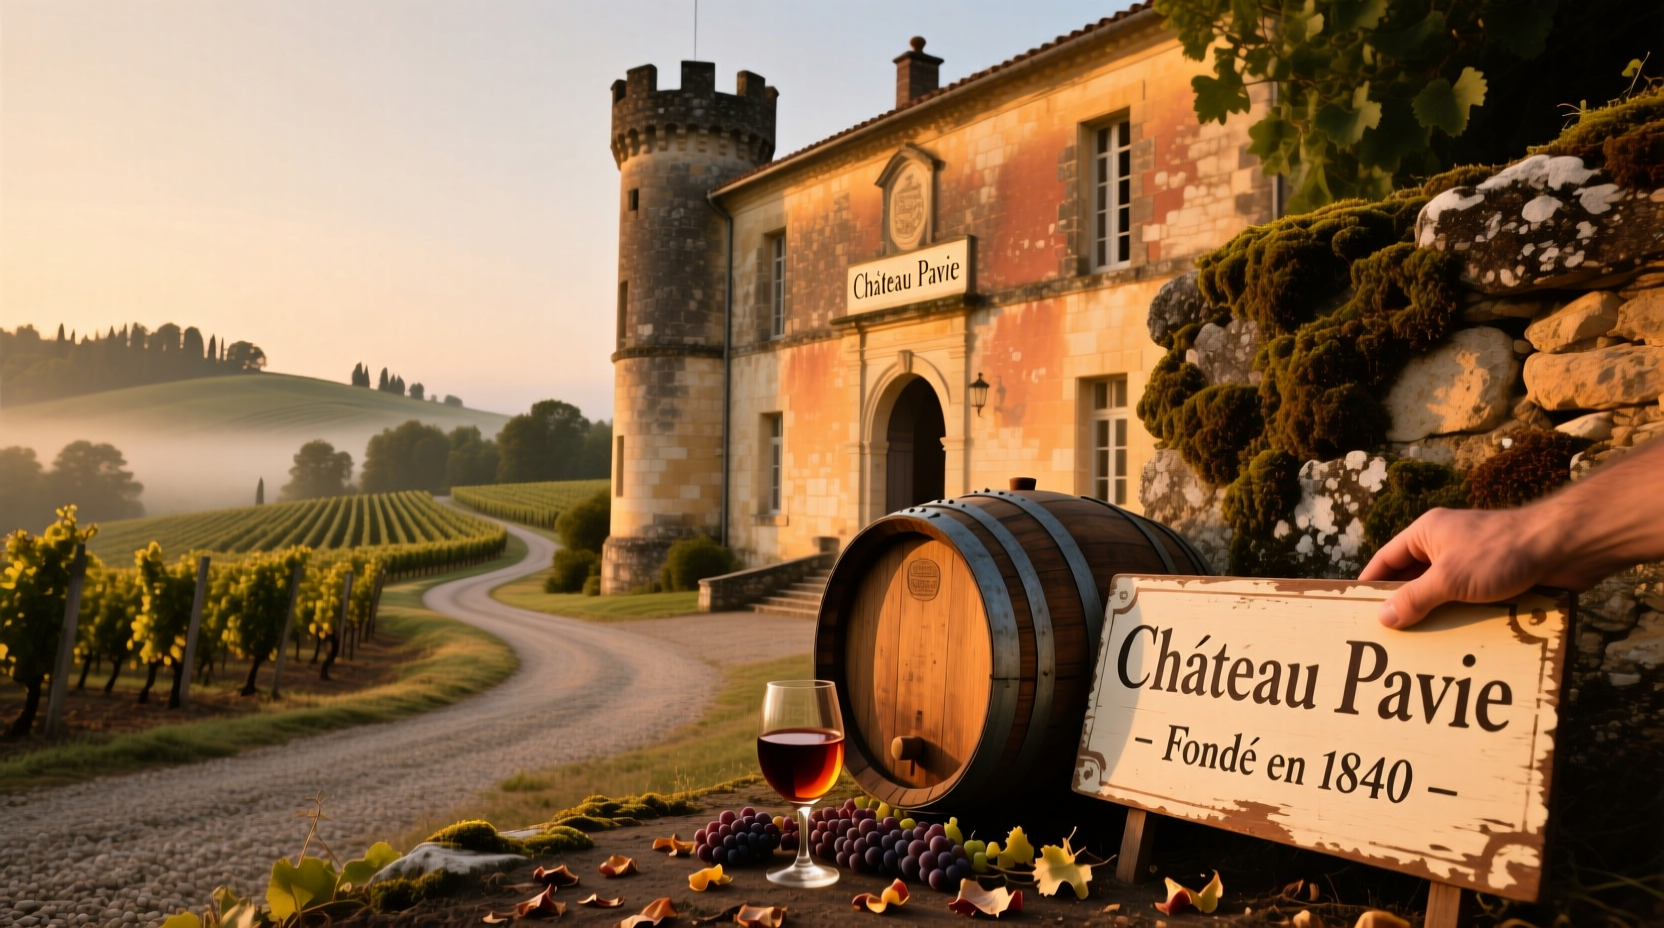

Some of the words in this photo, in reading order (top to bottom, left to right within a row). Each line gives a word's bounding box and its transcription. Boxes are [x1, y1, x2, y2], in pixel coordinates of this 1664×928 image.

[917, 254, 960, 288] Pavie
[1333, 639, 1513, 733] Pavie
[1161, 724, 1262, 776] Fondé
[1266, 754, 1306, 786] en
[1317, 750, 1414, 804] 1840
